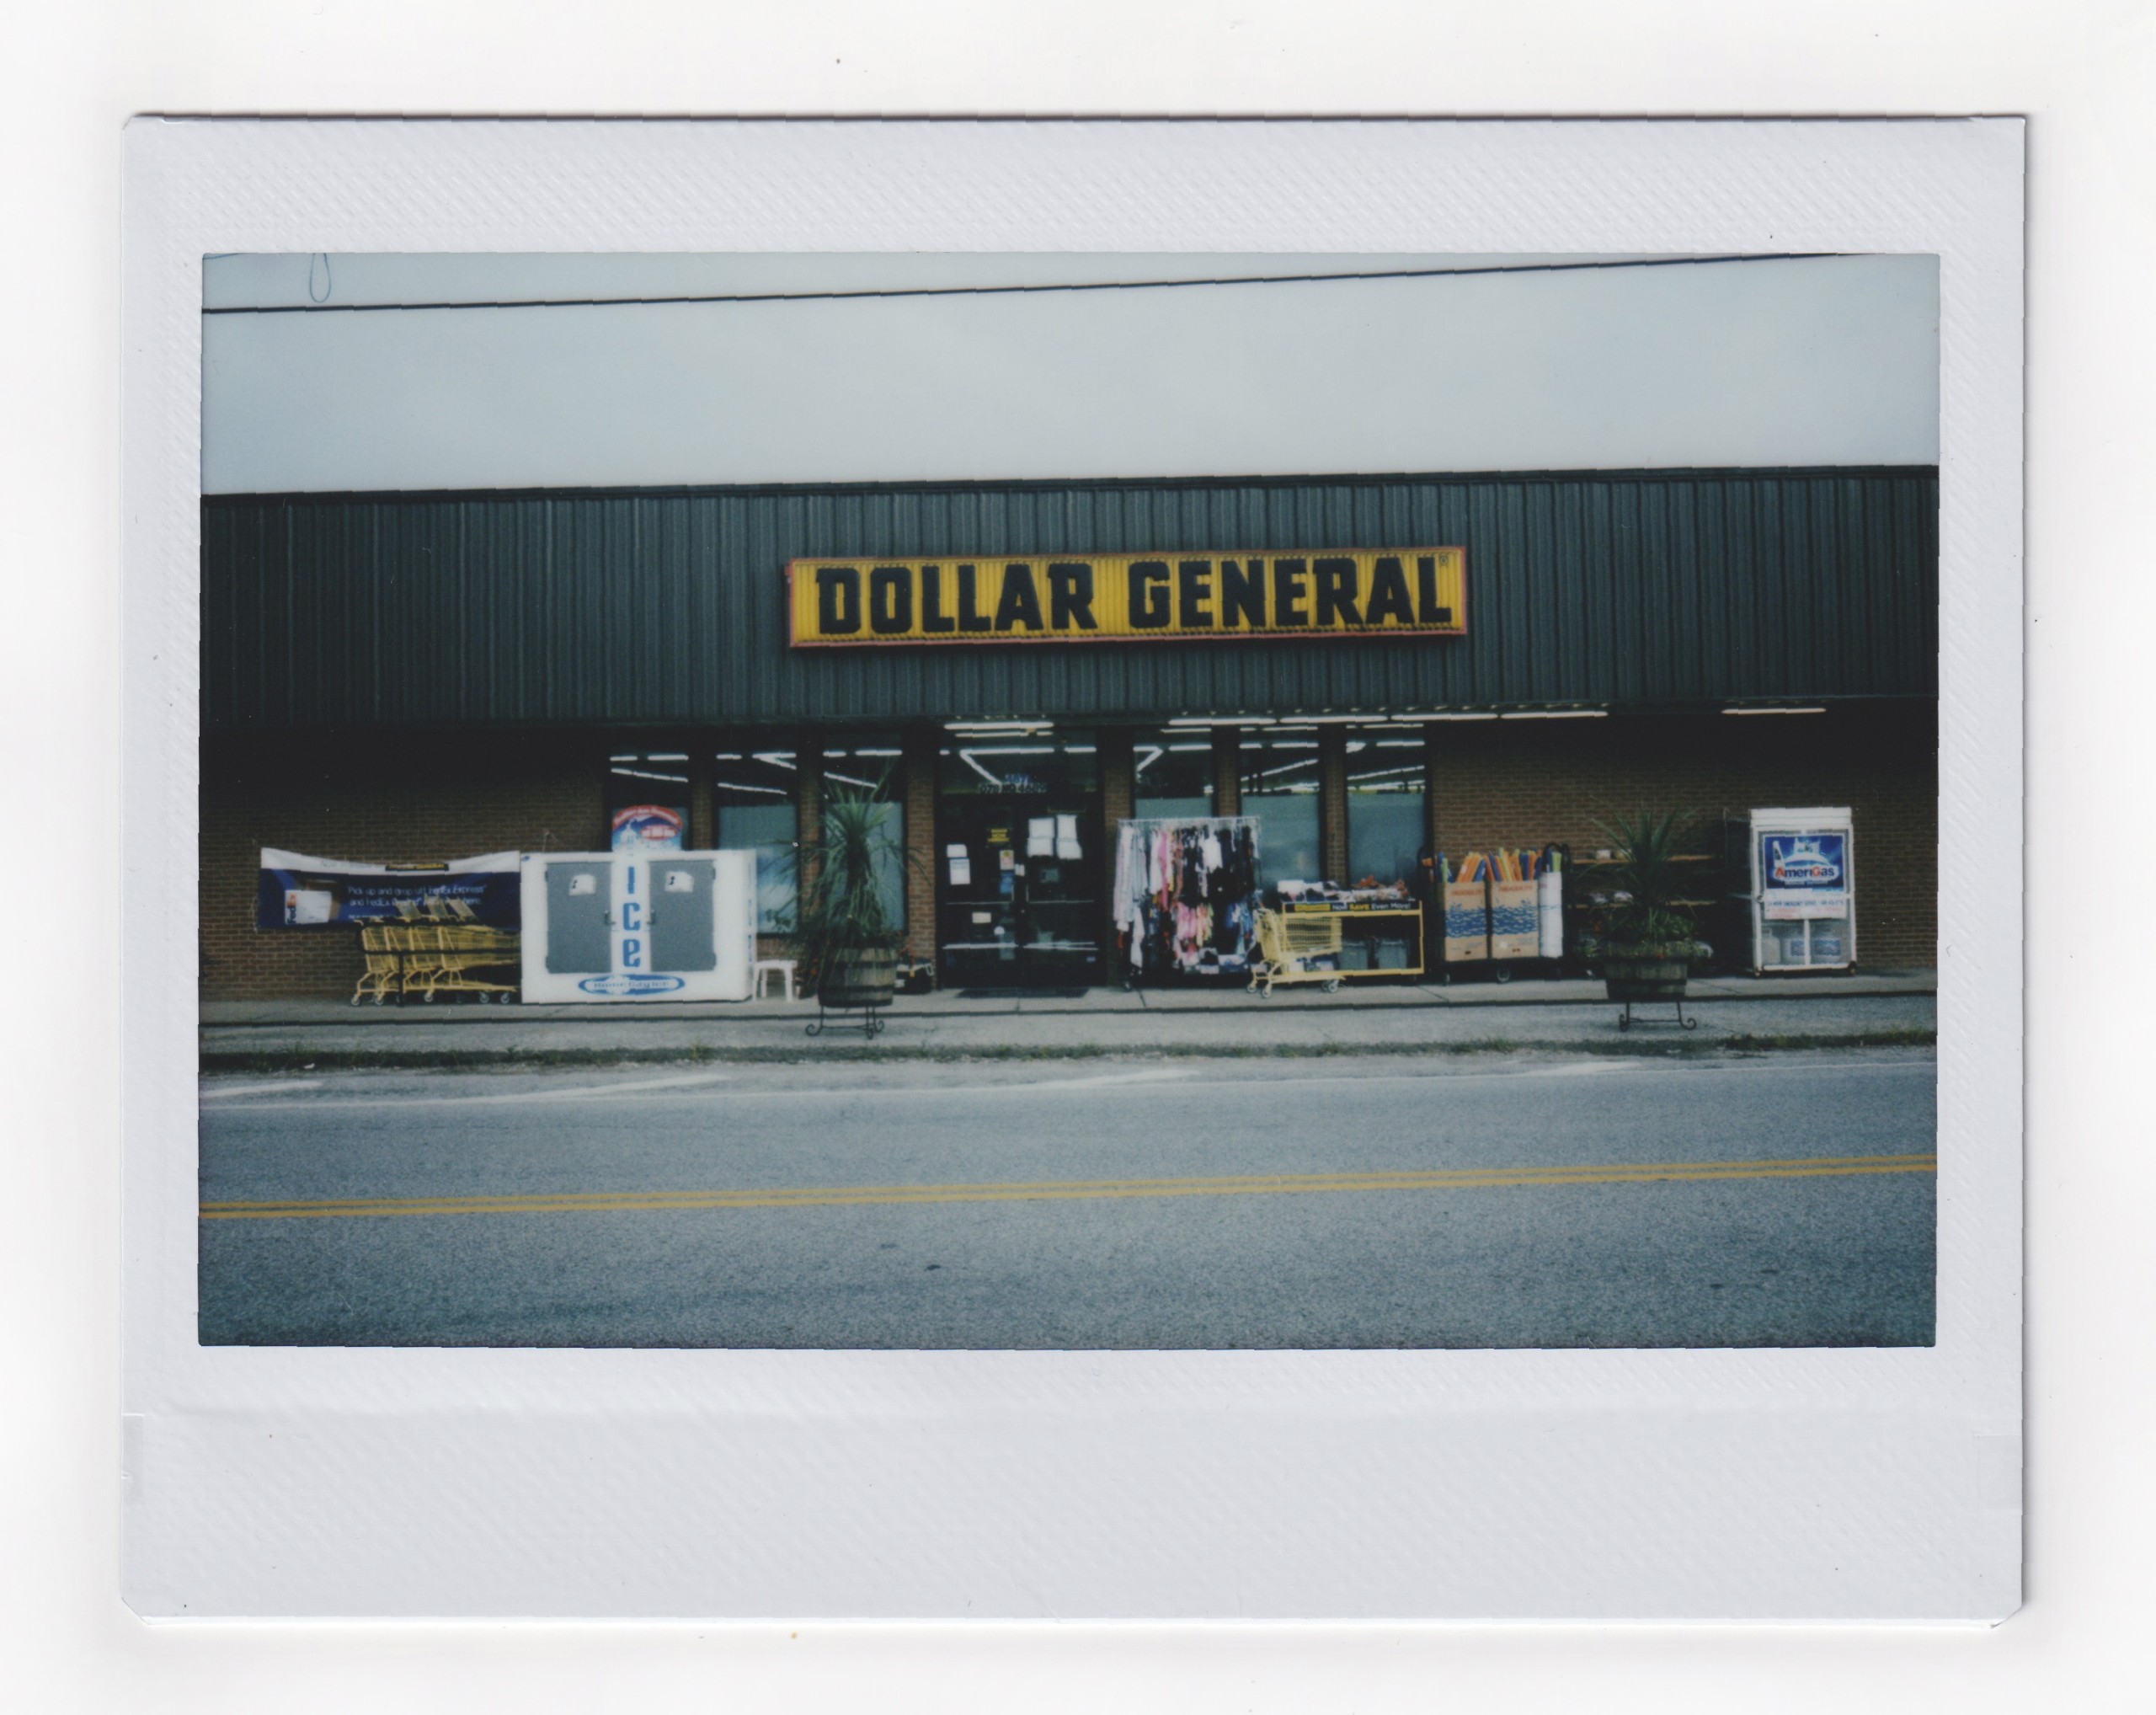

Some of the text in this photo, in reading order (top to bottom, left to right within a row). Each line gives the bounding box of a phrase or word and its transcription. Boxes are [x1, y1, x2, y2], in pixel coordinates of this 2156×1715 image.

[815, 556, 1452, 635] DOLLAR GENERAL
[1774, 866, 1835, 878] AmeriGas
[377, 887, 392, 895] and
